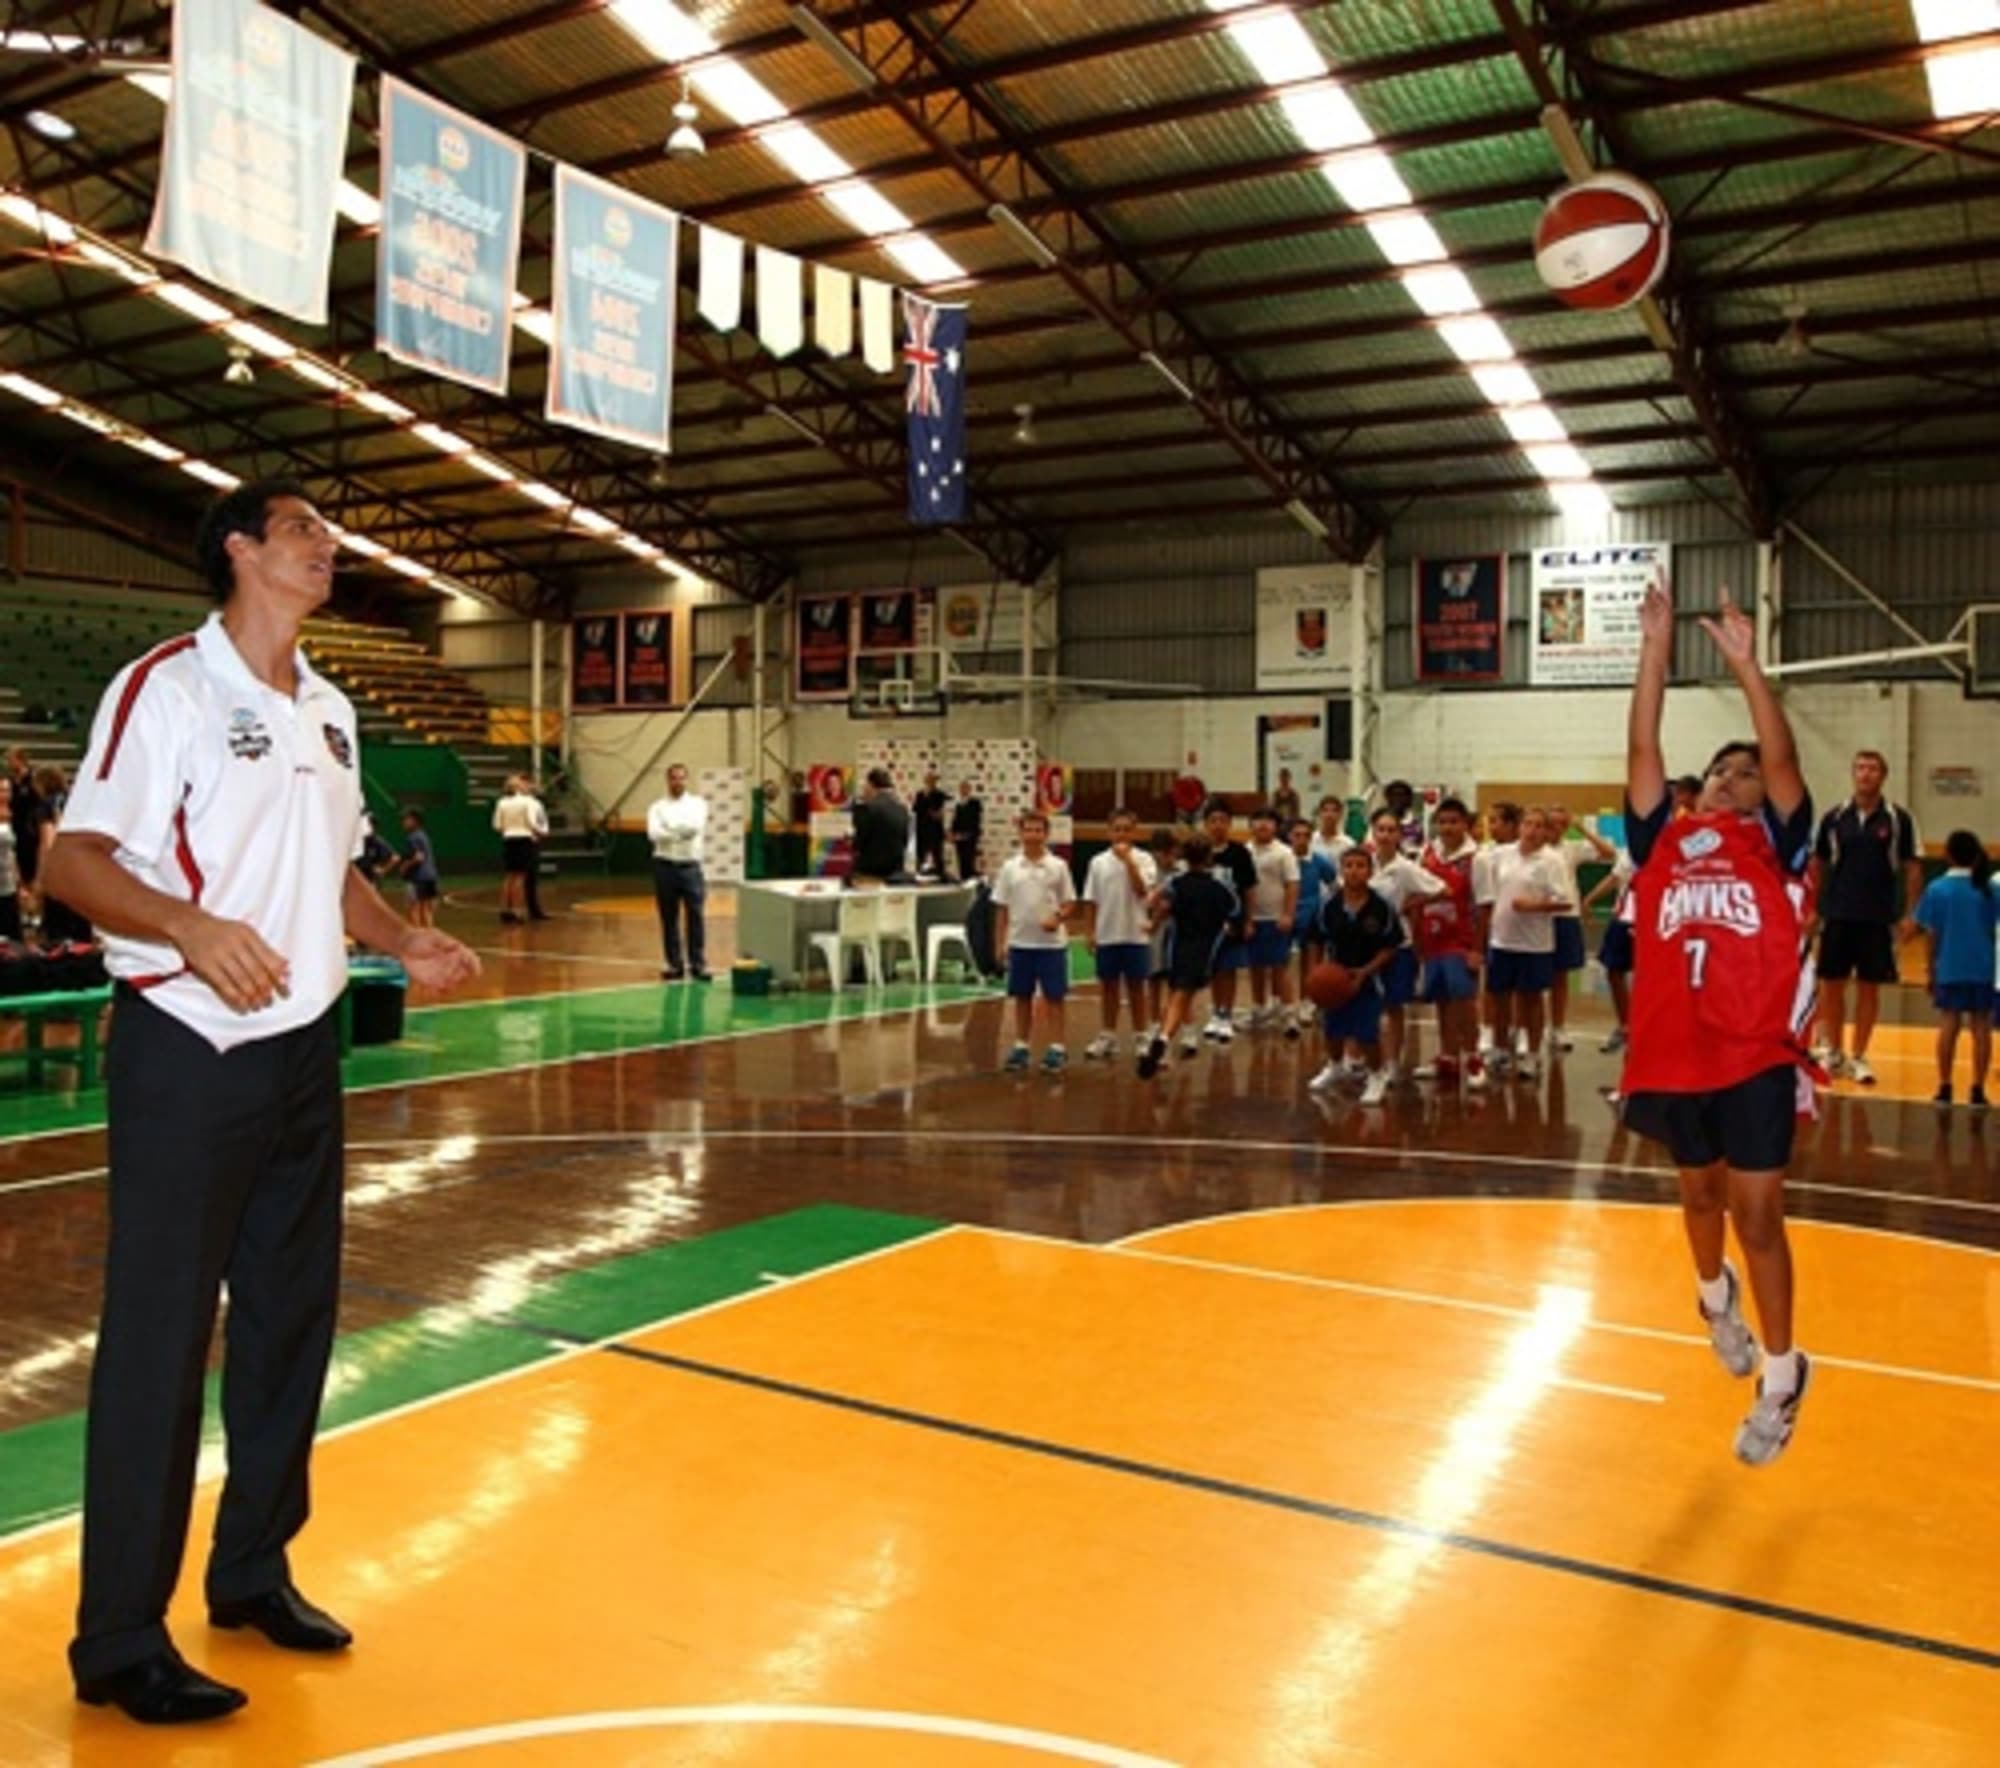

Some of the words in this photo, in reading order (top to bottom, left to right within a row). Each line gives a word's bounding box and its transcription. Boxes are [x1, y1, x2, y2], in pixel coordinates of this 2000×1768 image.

[1540, 547, 1659, 568] ELITE
[1592, 591, 1643, 602] ELIT
[1683, 938, 1707, 988] 7
